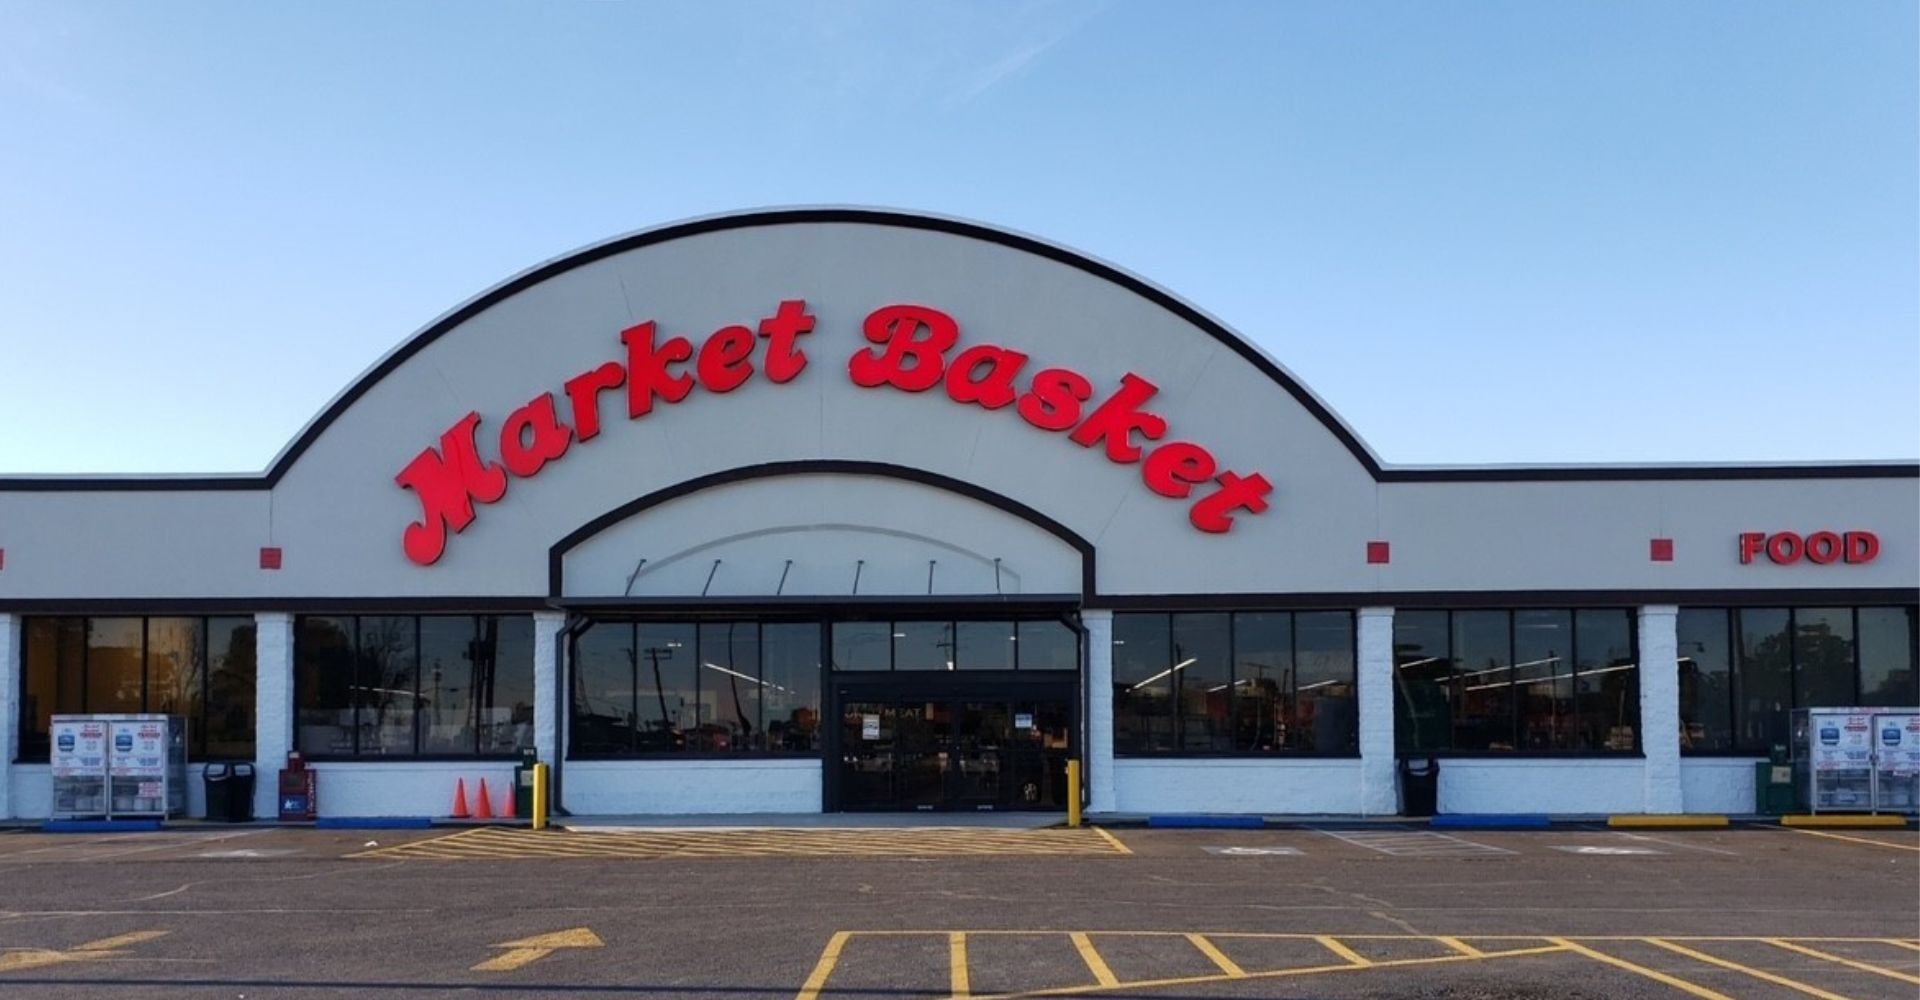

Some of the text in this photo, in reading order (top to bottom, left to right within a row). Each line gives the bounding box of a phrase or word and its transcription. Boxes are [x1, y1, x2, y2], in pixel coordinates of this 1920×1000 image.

[395, 300, 1275, 566] Market Basket
[1739, 531, 1881, 565] FOOD
